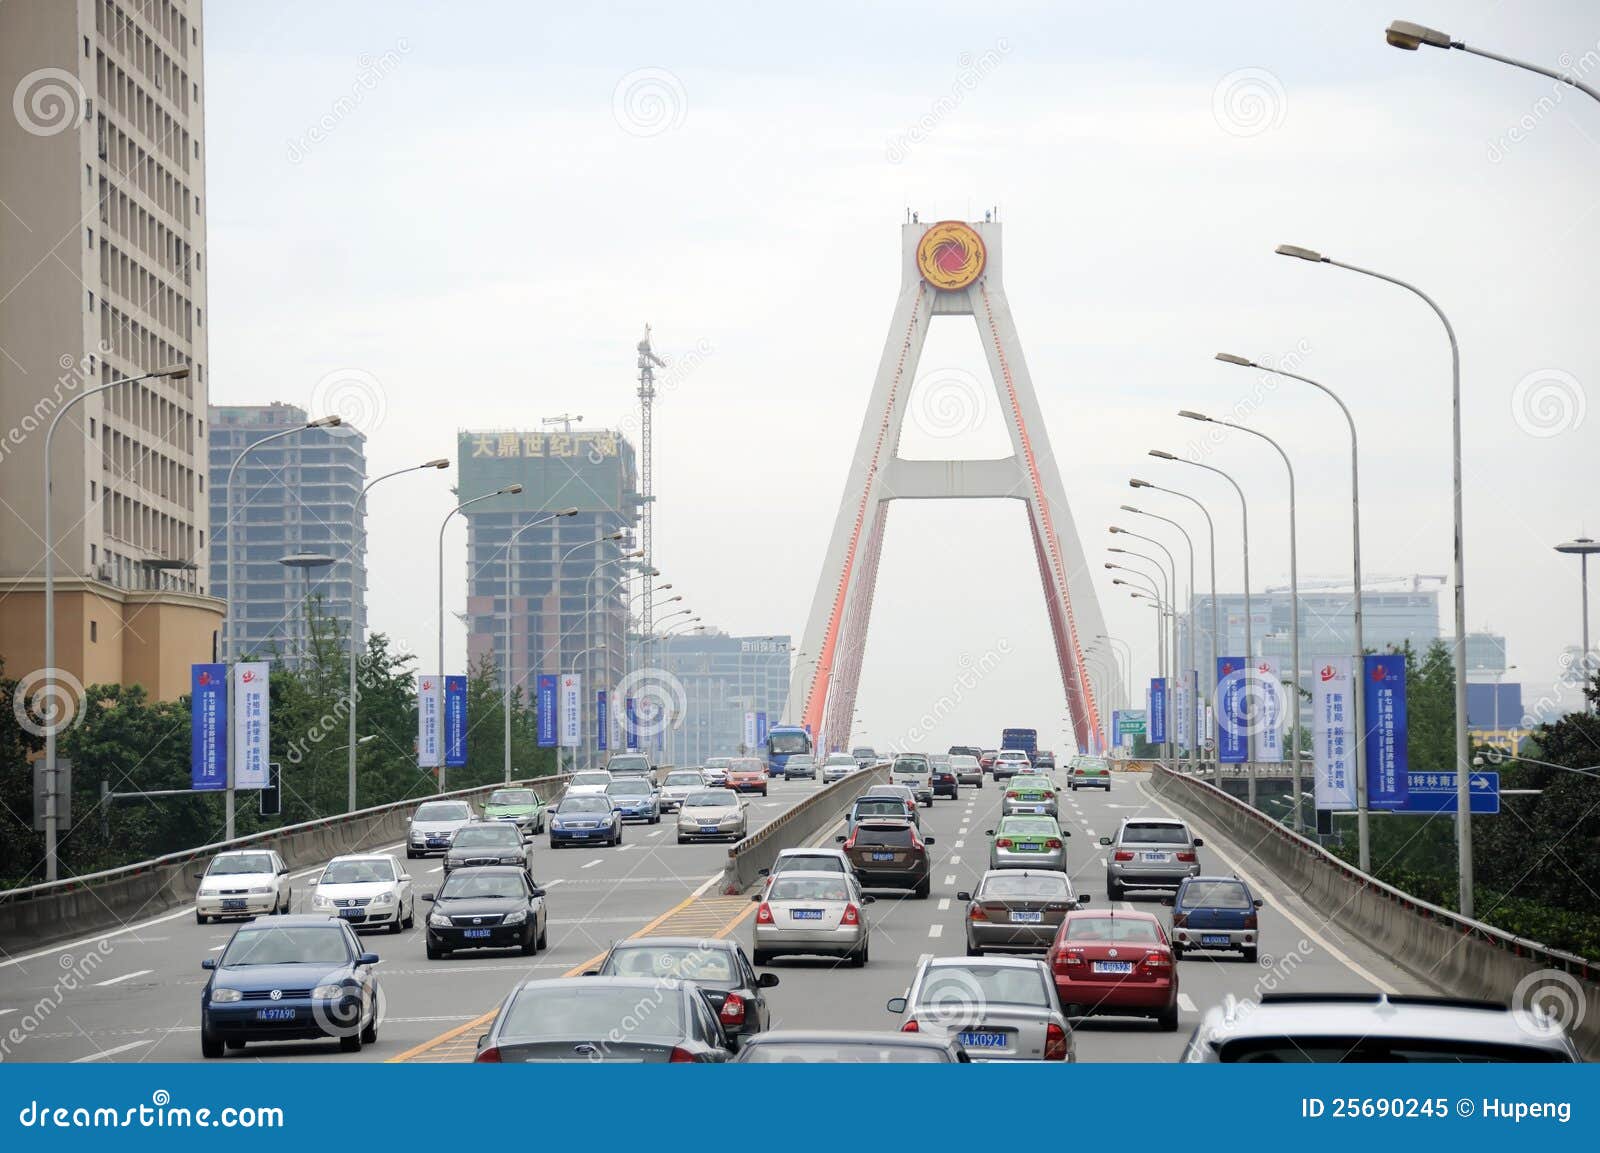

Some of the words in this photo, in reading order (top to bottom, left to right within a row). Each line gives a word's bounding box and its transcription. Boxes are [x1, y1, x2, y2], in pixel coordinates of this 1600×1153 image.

[472, 433, 617, 458] 大鼎世纪广场
